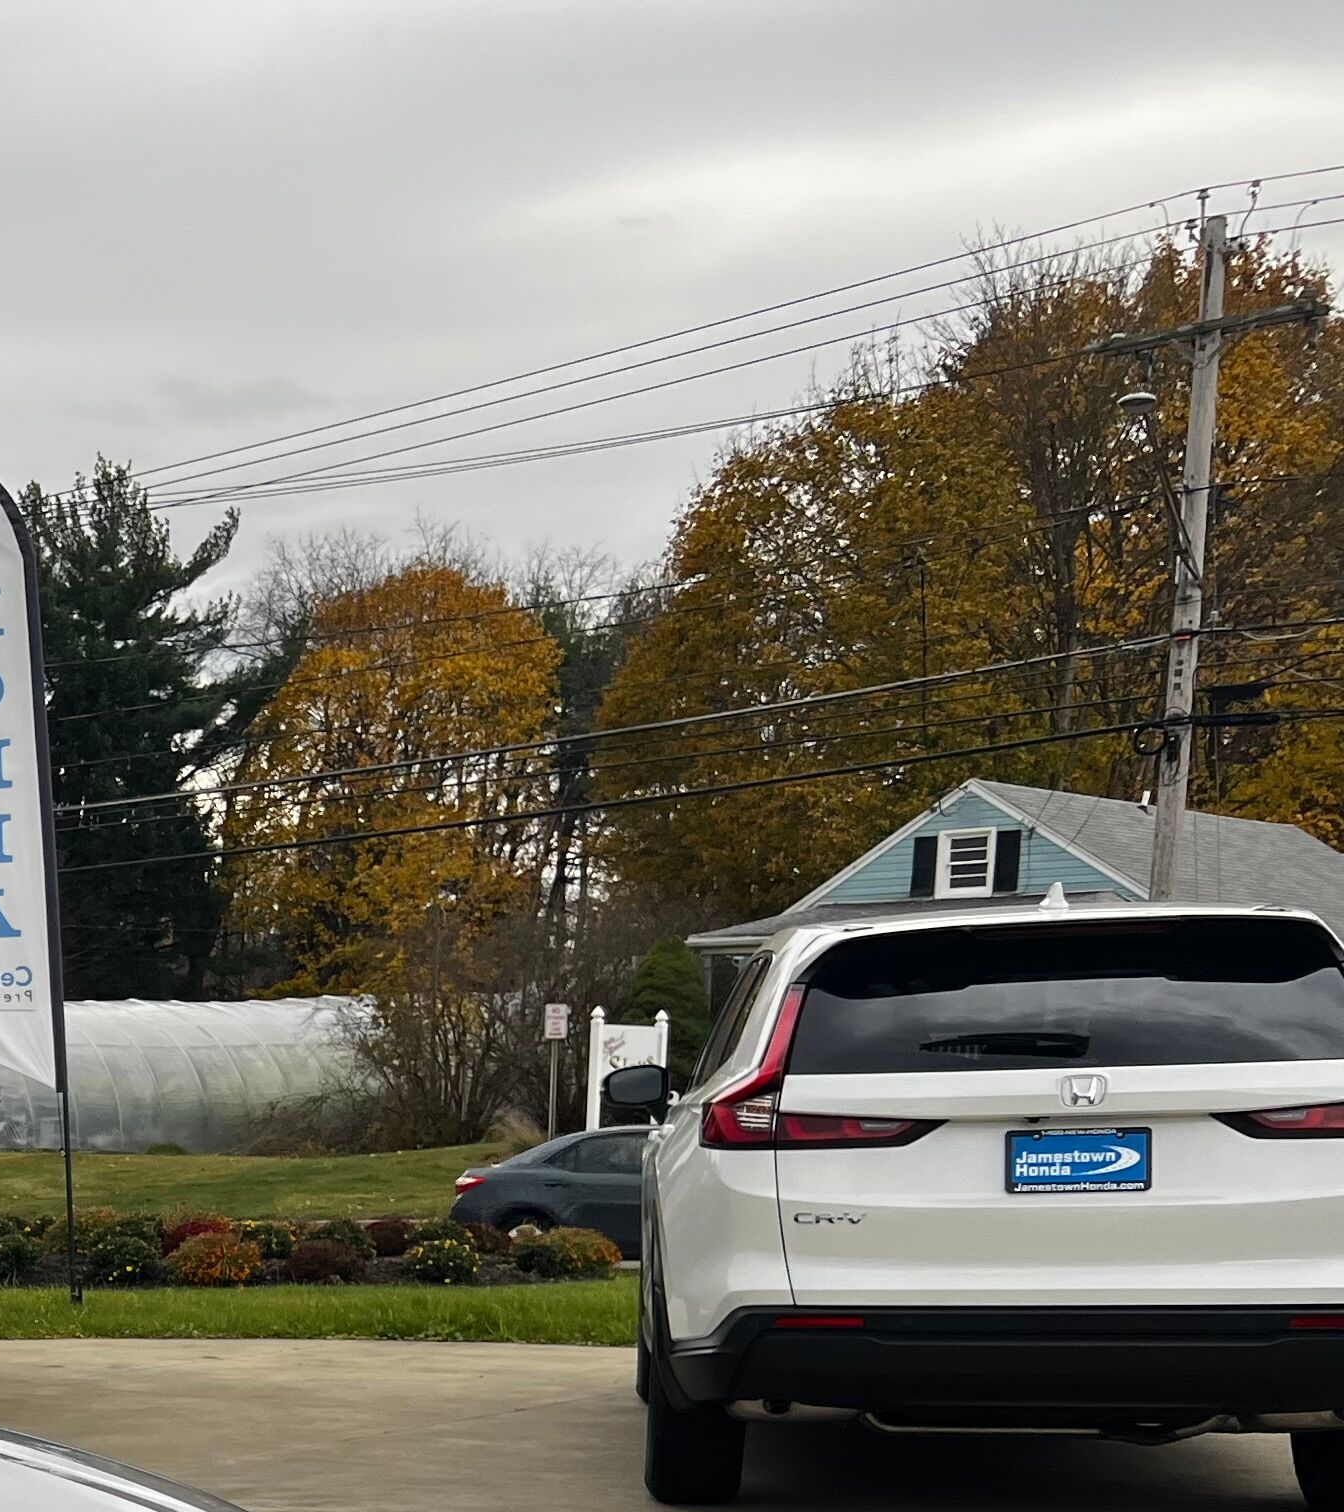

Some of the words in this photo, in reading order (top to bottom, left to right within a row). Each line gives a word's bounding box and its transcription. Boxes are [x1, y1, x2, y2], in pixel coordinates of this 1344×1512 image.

[1016, 1150, 1116, 1164] Jamestown
[1015, 1163, 1071, 1177] Honda
[1014, 1181, 1144, 1192] JamestownHonda.com
